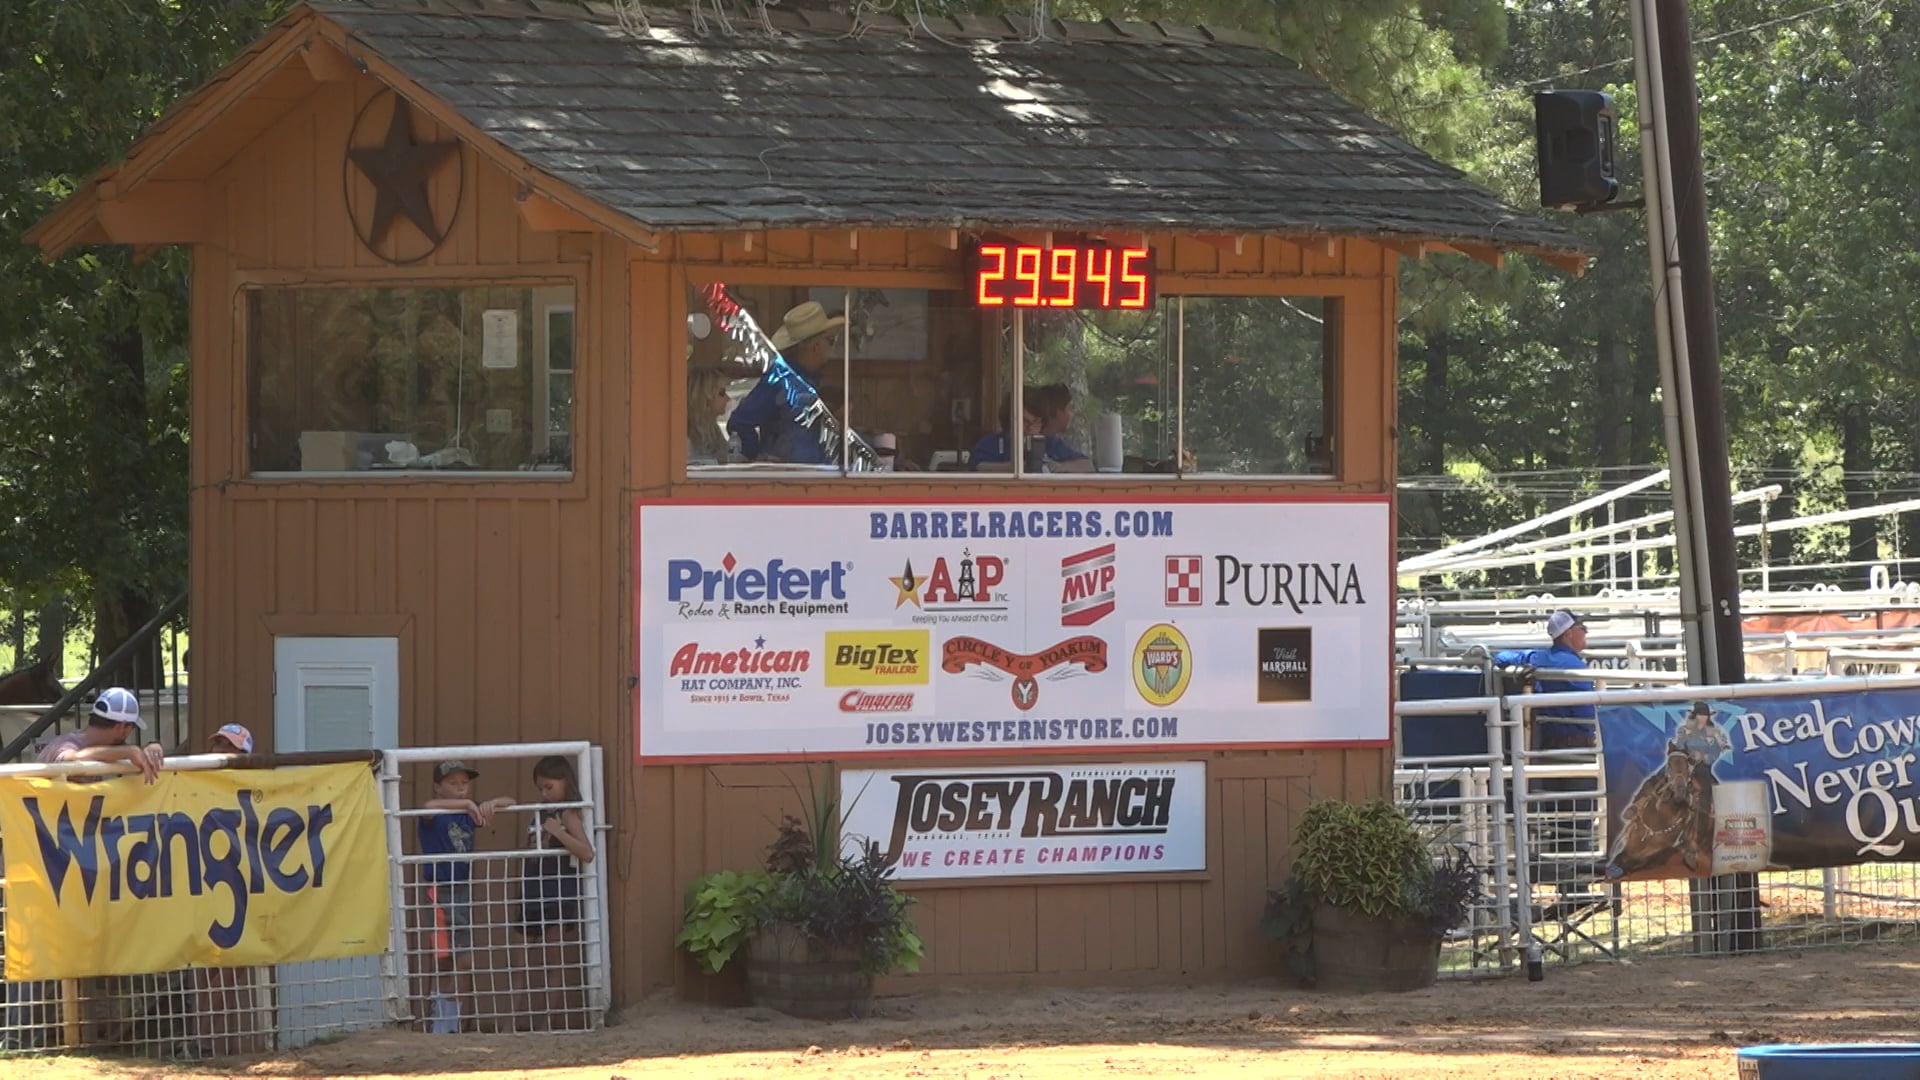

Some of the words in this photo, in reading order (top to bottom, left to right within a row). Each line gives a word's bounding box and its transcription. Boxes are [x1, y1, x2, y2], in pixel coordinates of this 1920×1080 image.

[978, 246, 1149, 308] 29.945
[870, 511, 1173, 538] BARRELRACERS.COM
[668, 552, 847, 601] Priefert
[1062, 565, 1115, 604] MVP
[1215, 556, 1365, 613] PURINA
[678, 601, 714, 620] Rodeo
[718, 604, 731, 620] &
[734, 601, 775, 614] Ranch
[780, 601, 849, 616] Equipment
[670, 642, 810, 678] American
[946, 639, 1000, 661] CIRCLE
[1005, 656, 1015, 668] Y
[1040, 640, 1100, 667] YOAKUM
[1146, 651, 1179, 666] WARD'S
[1262, 661, 1308, 674] MARSHALL
[681, 679, 706, 690] HAT
[709, 678, 774, 691] COMPANY,
[776, 677, 802, 689] INC.
[875, 665, 918, 675] TRAILERS
[866, 717, 1178, 744] JOSEYWESTERNSTORE.COM
[1737, 699, 1826, 752] Real
[1823, 714, 1920, 759] Cow
[1764, 753, 1917, 815] Never
[1020, 772, 1175, 838] RANCH
[22, 789, 333, 948] Wrangler
[903, 851, 932, 867] WE
[944, 848, 1026, 866] CREATE
[1037, 844, 1166, 863] CHAMPIONS
